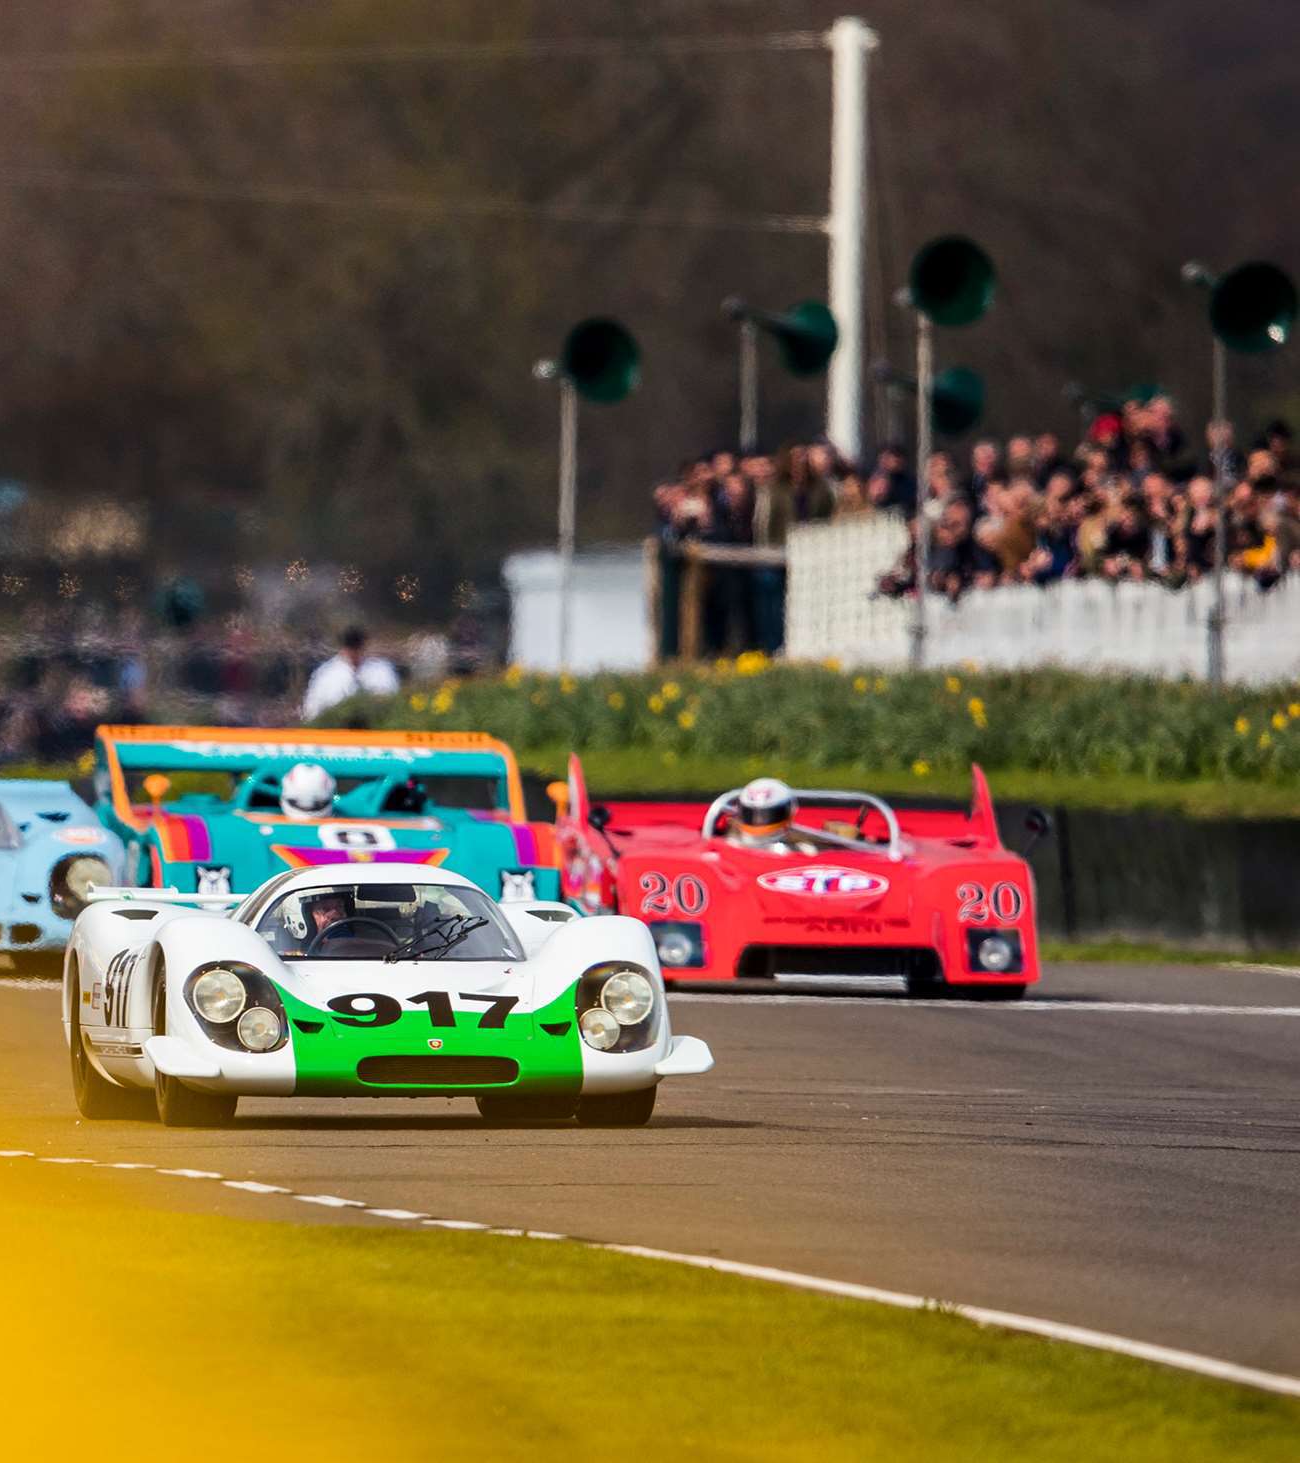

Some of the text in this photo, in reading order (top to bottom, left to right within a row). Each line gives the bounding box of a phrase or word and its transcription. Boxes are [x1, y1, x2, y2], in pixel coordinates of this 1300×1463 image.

[639, 871, 707, 916] 20
[956, 881, 1024, 922] 20
[103, 948, 138, 1027] 917
[326, 991, 520, 1029] 917
